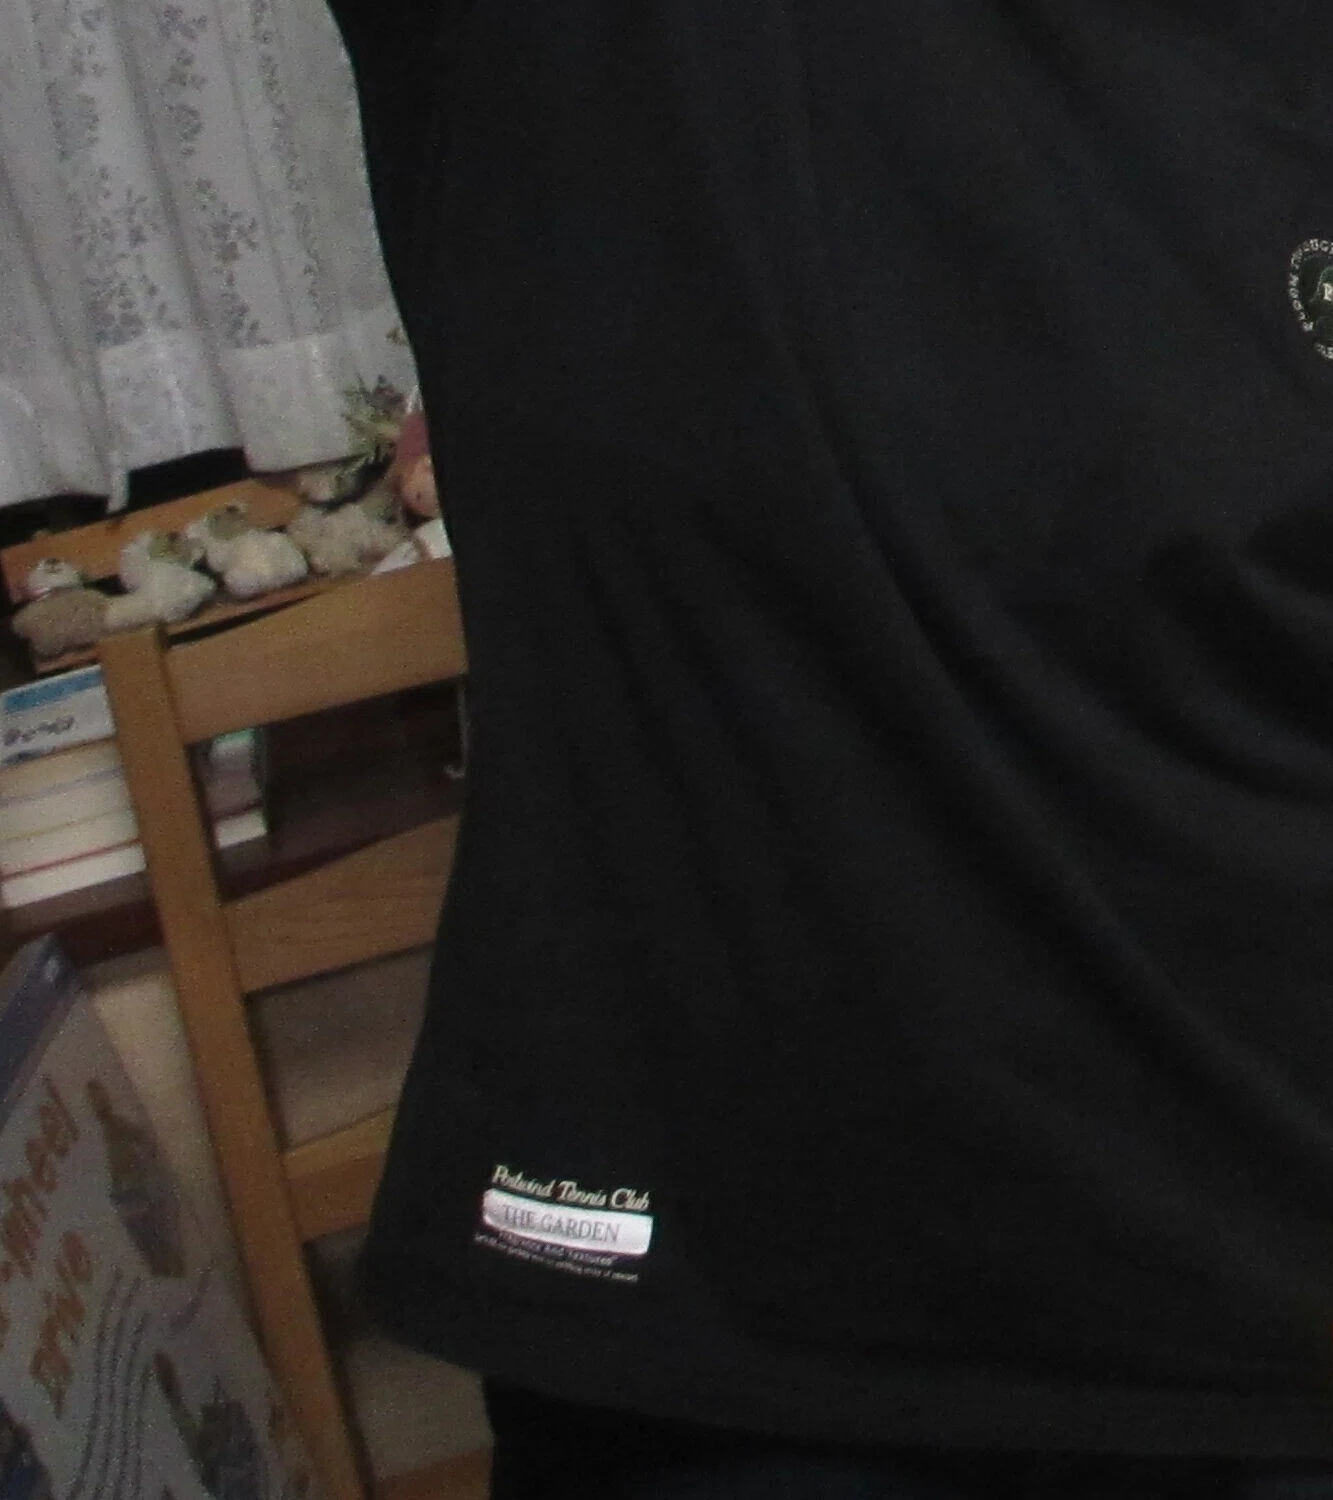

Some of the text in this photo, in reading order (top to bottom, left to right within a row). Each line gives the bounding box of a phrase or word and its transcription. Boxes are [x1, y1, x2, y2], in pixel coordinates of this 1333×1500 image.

[556, 1179, 607, 1208] Tennis
[610, 1186, 652, 1212] Club
[502, 1204, 622, 1243] THE GARDEN
